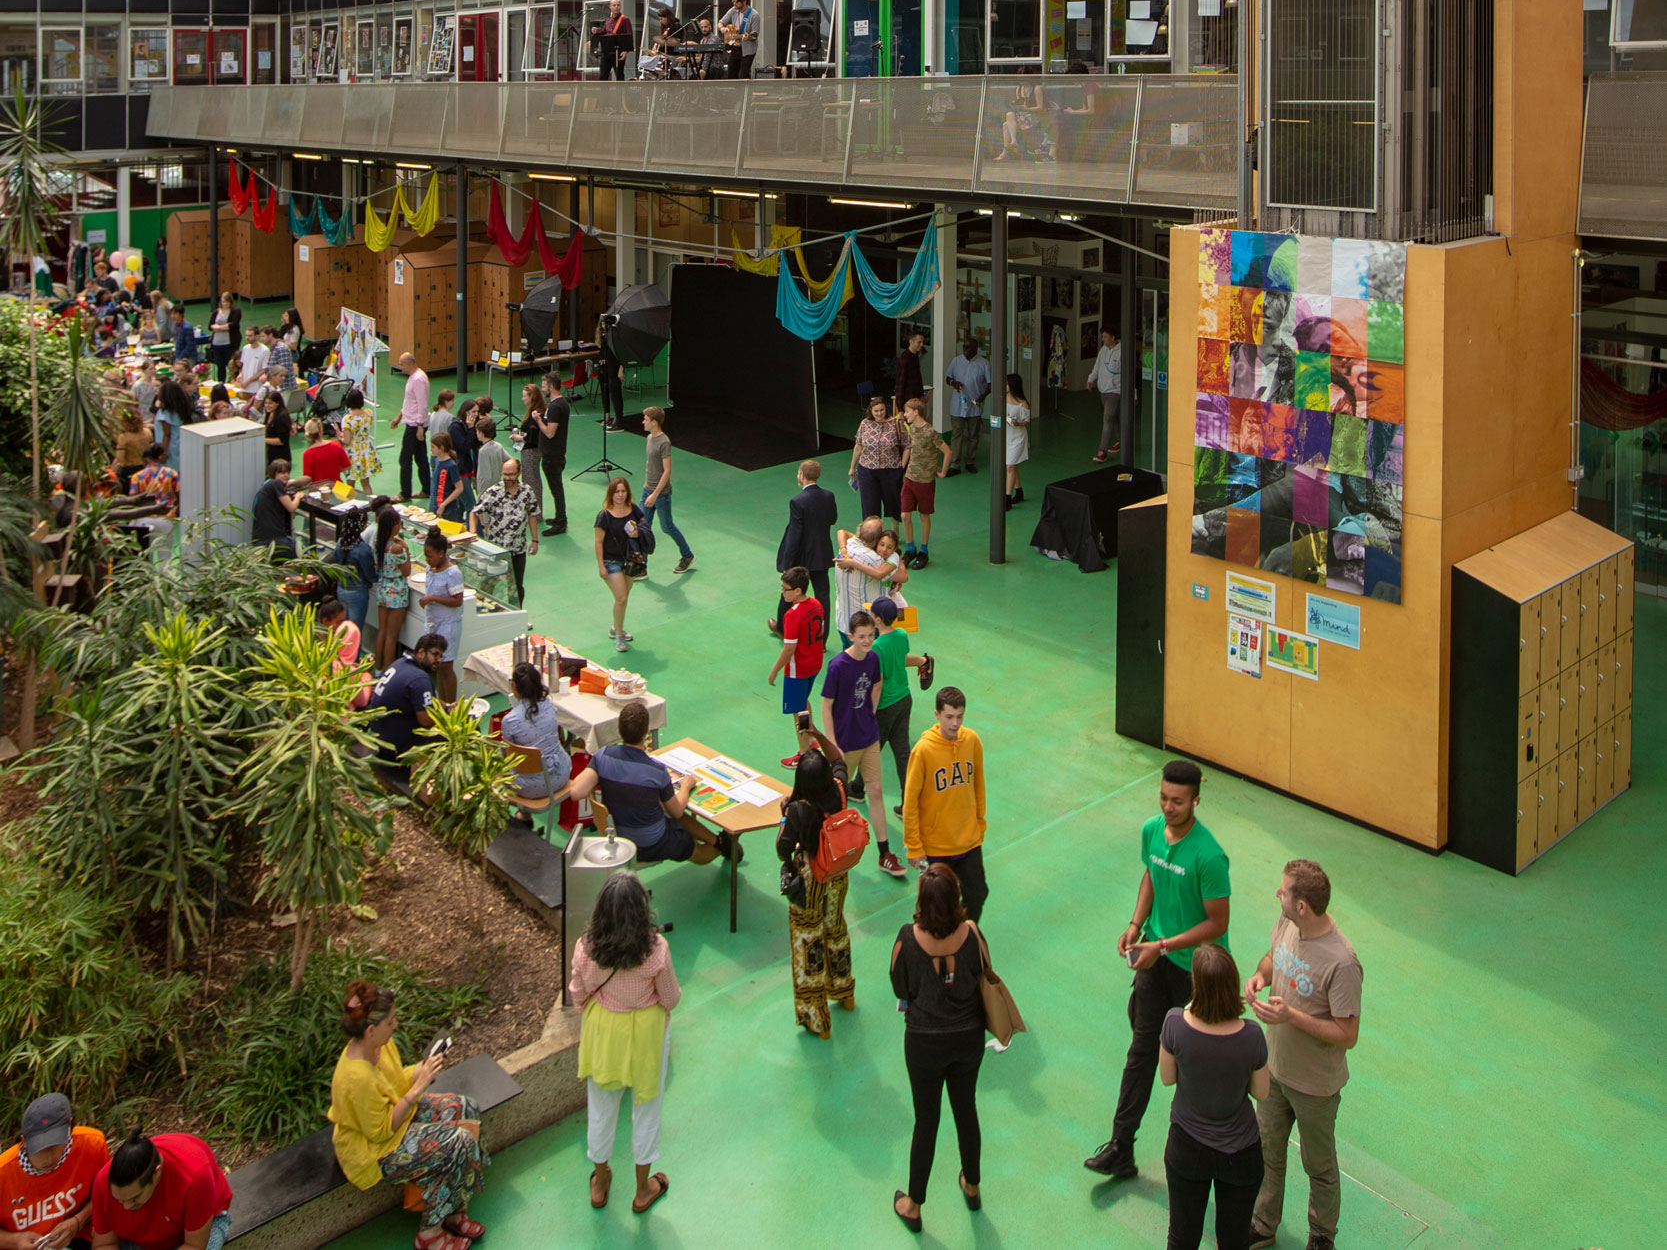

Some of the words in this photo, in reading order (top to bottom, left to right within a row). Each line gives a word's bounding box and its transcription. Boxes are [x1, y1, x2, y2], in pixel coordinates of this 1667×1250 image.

[807, 615, 824, 646] 12
[374, 667, 397, 697] 2
[423, 691, 433, 706] 2
[934, 761, 974, 792] GAP
[12, 1187, 77, 1230] GUESS
